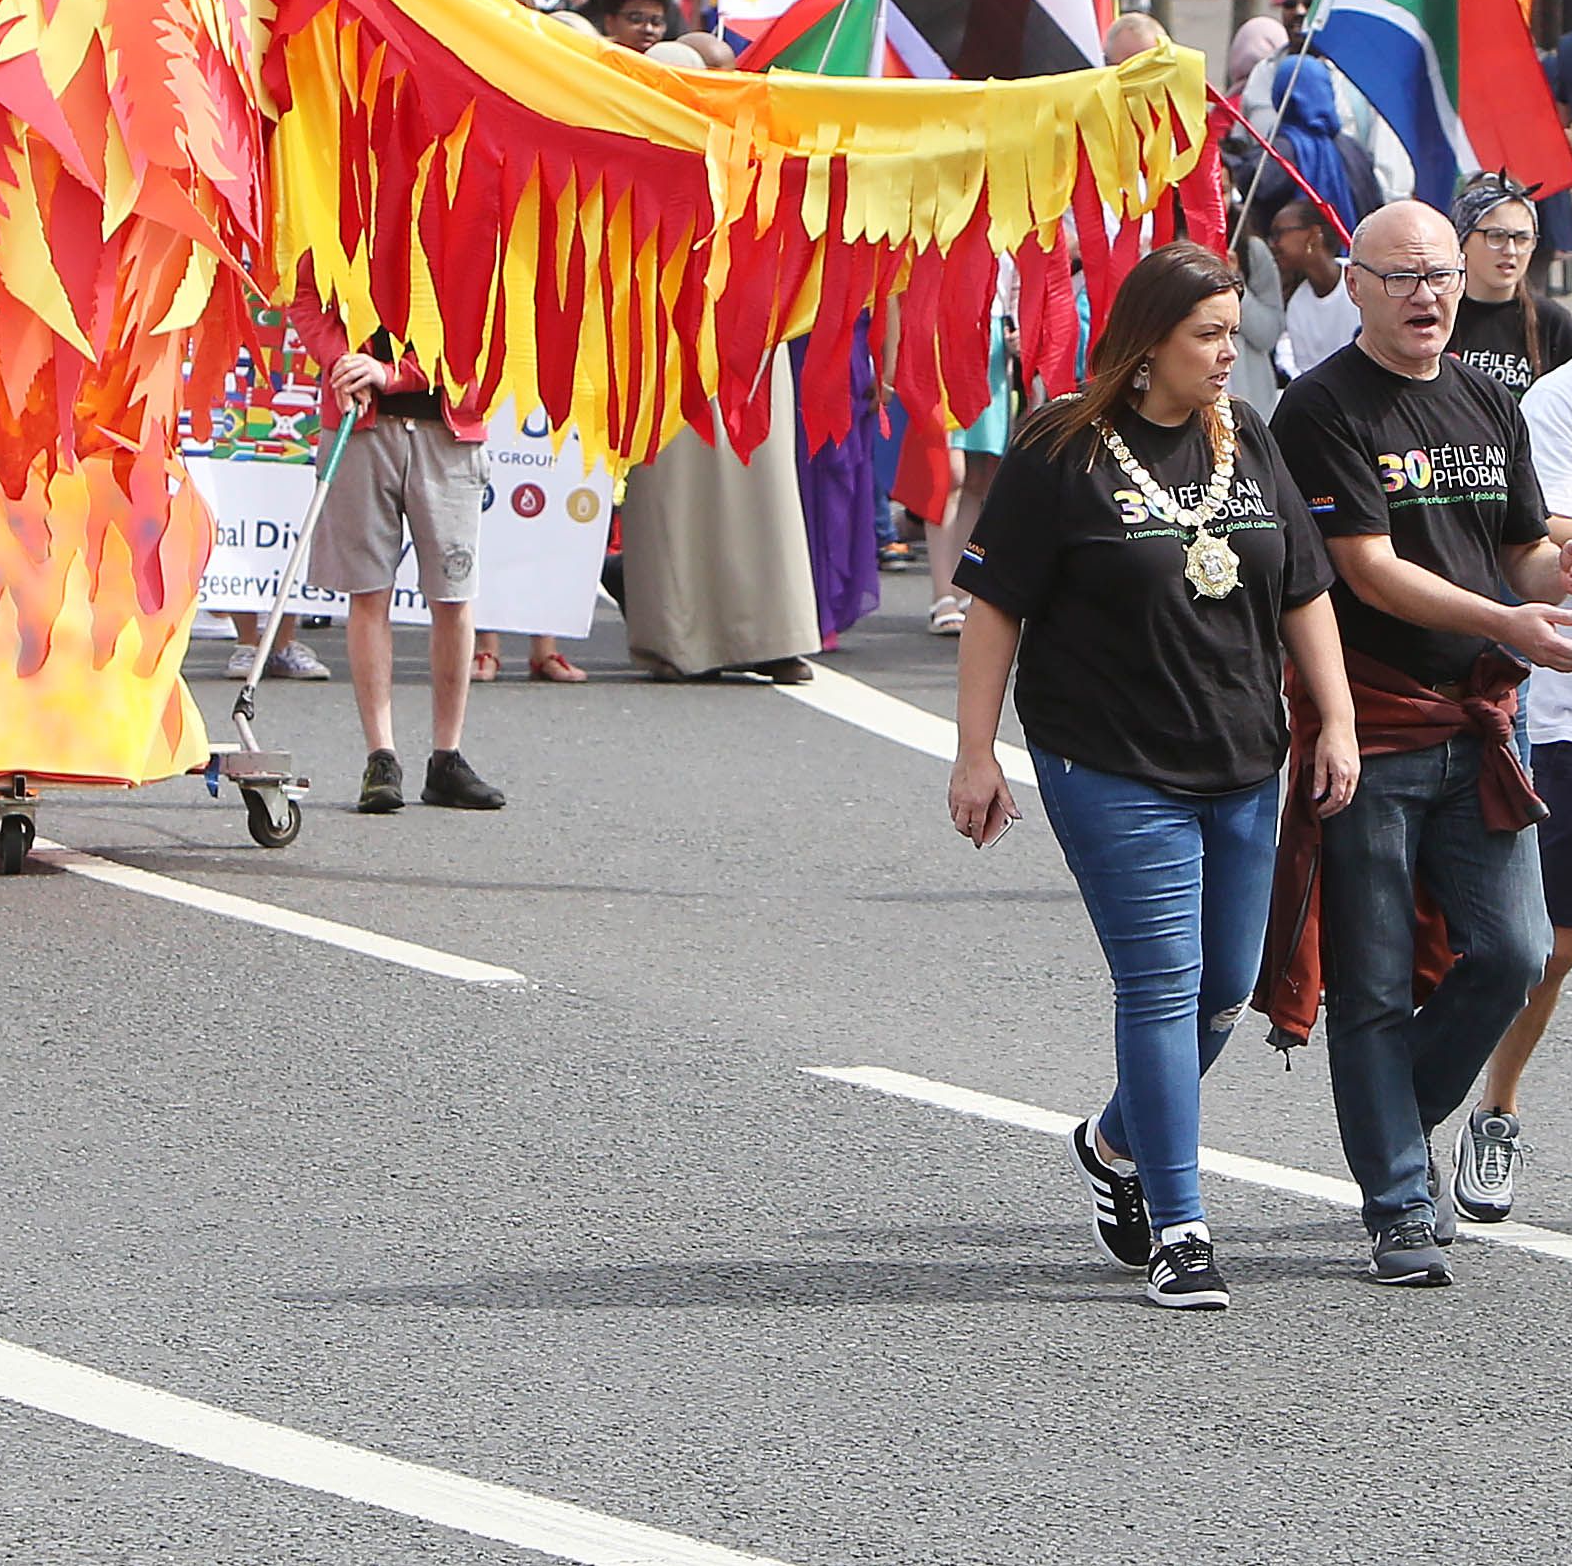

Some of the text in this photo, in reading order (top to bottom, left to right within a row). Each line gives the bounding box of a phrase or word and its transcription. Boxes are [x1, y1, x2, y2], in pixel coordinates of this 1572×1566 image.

[1430, 443, 1506, 469] FÉILE AN
[1378, 449, 1432, 493] 30
[1235, 478, 1263, 498] AN
[1133, 526, 1178, 540] community
[1226, 518, 1253, 533] global
